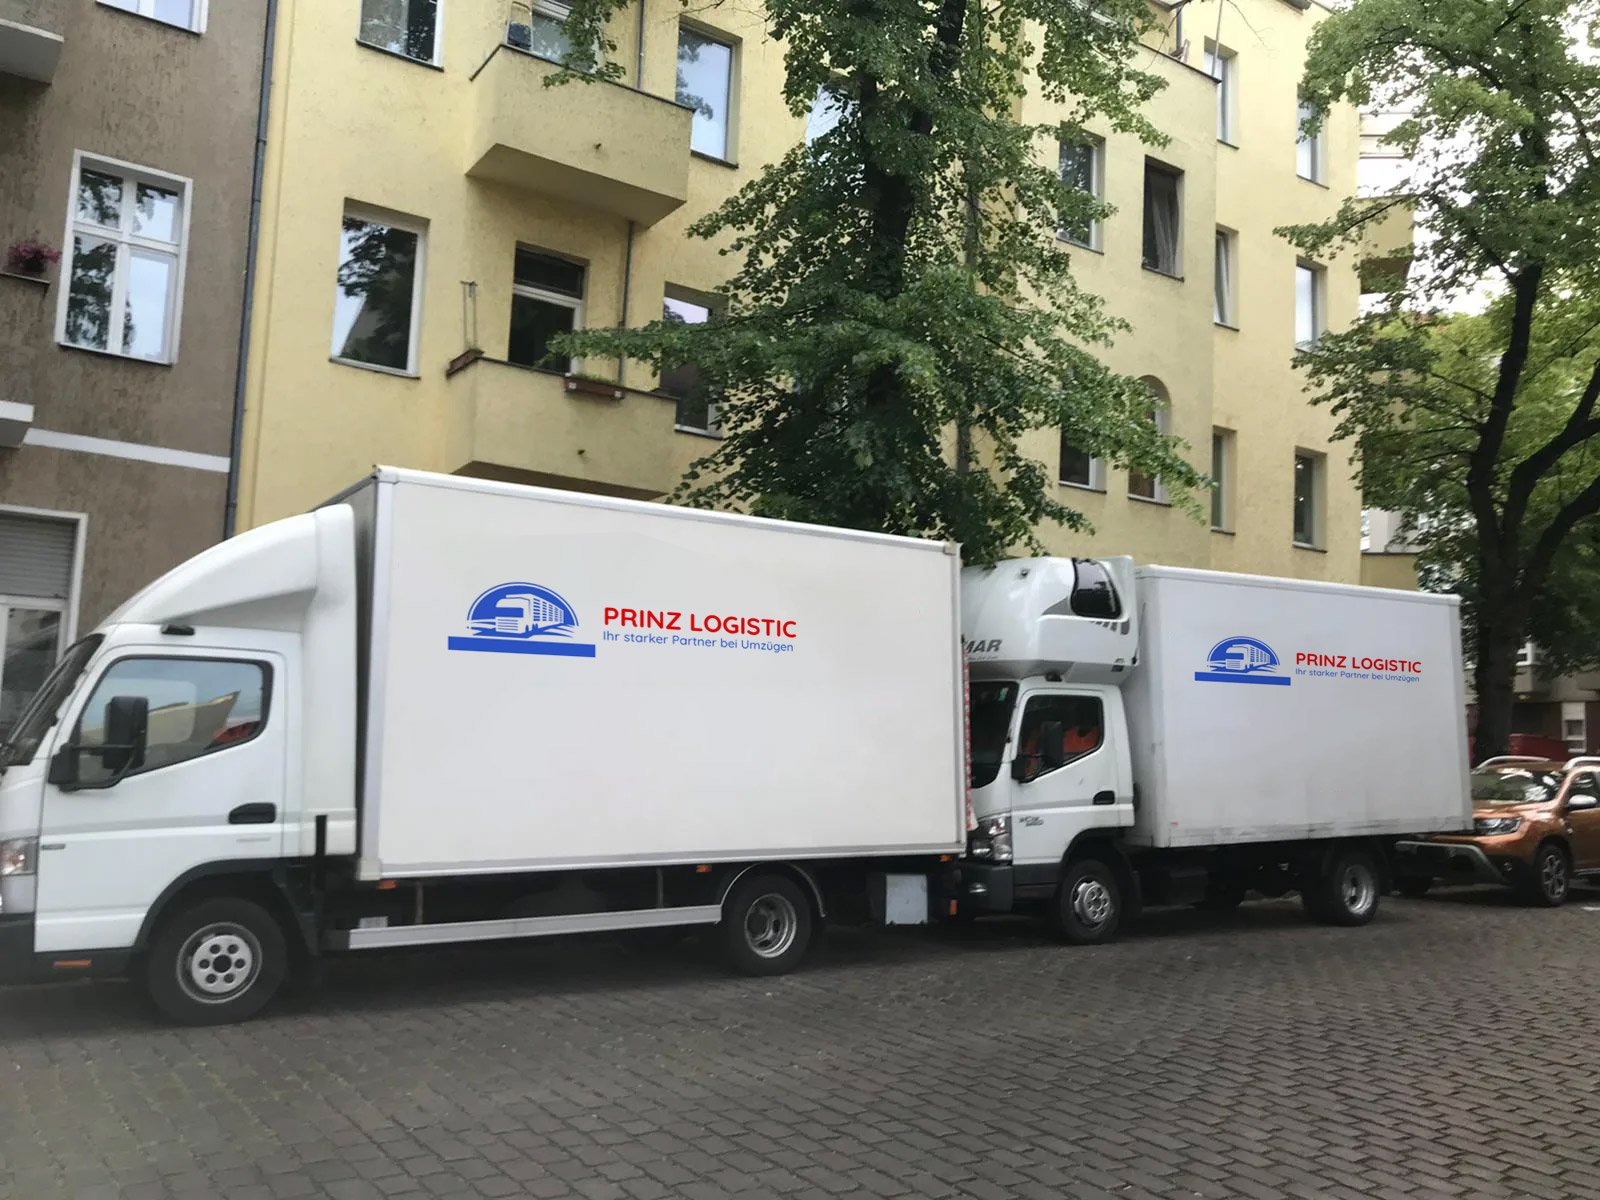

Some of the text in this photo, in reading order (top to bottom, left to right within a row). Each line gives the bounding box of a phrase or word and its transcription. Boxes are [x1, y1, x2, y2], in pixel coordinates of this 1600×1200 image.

[604, 607, 797, 638] PRINZ LOGISTIC
[603, 630, 794, 653] Ihr starker Partner bei Umzügen
[1296, 653, 1422, 673] PRINZ LOGISTIC
[1295, 668, 1420, 683] Ihr starker Partner bei Umzügen
